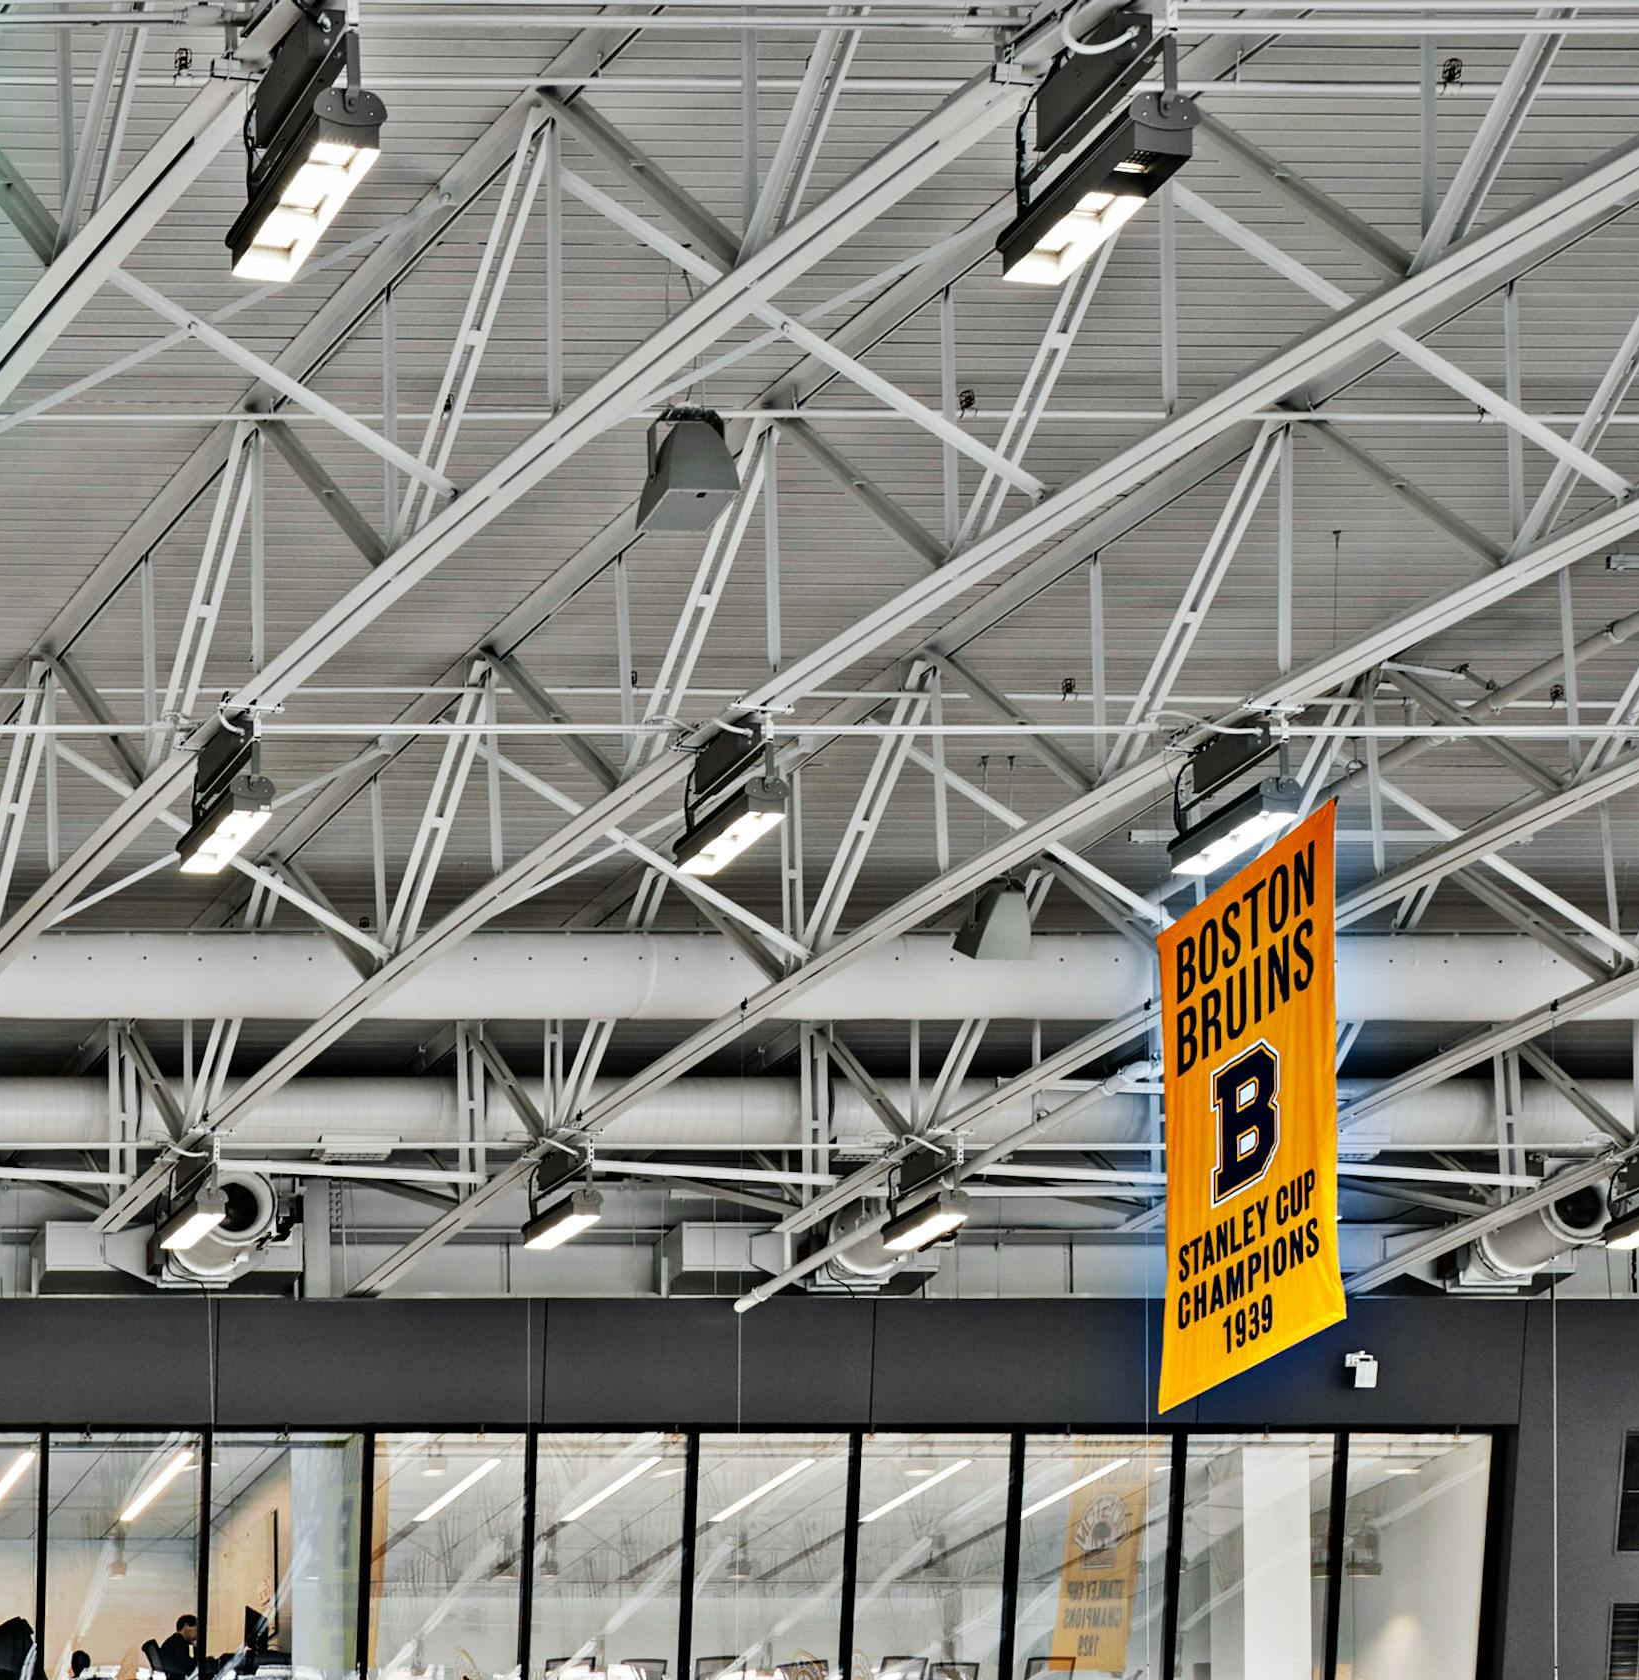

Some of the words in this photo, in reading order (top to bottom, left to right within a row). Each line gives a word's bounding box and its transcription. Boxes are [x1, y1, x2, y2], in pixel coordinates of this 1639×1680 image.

[1176, 840, 1316, 1005] BOSTON
[1176, 919, 1314, 1078] BRUINS
[1211, 1038, 1280, 1208] B
[1177, 1218, 1320, 1331] CHAMPIONS
[1179, 1198, 1270, 1282] STANLEY
[1276, 1169, 1316, 1228] CUP
[1222, 1294, 1273, 1354] 1939
